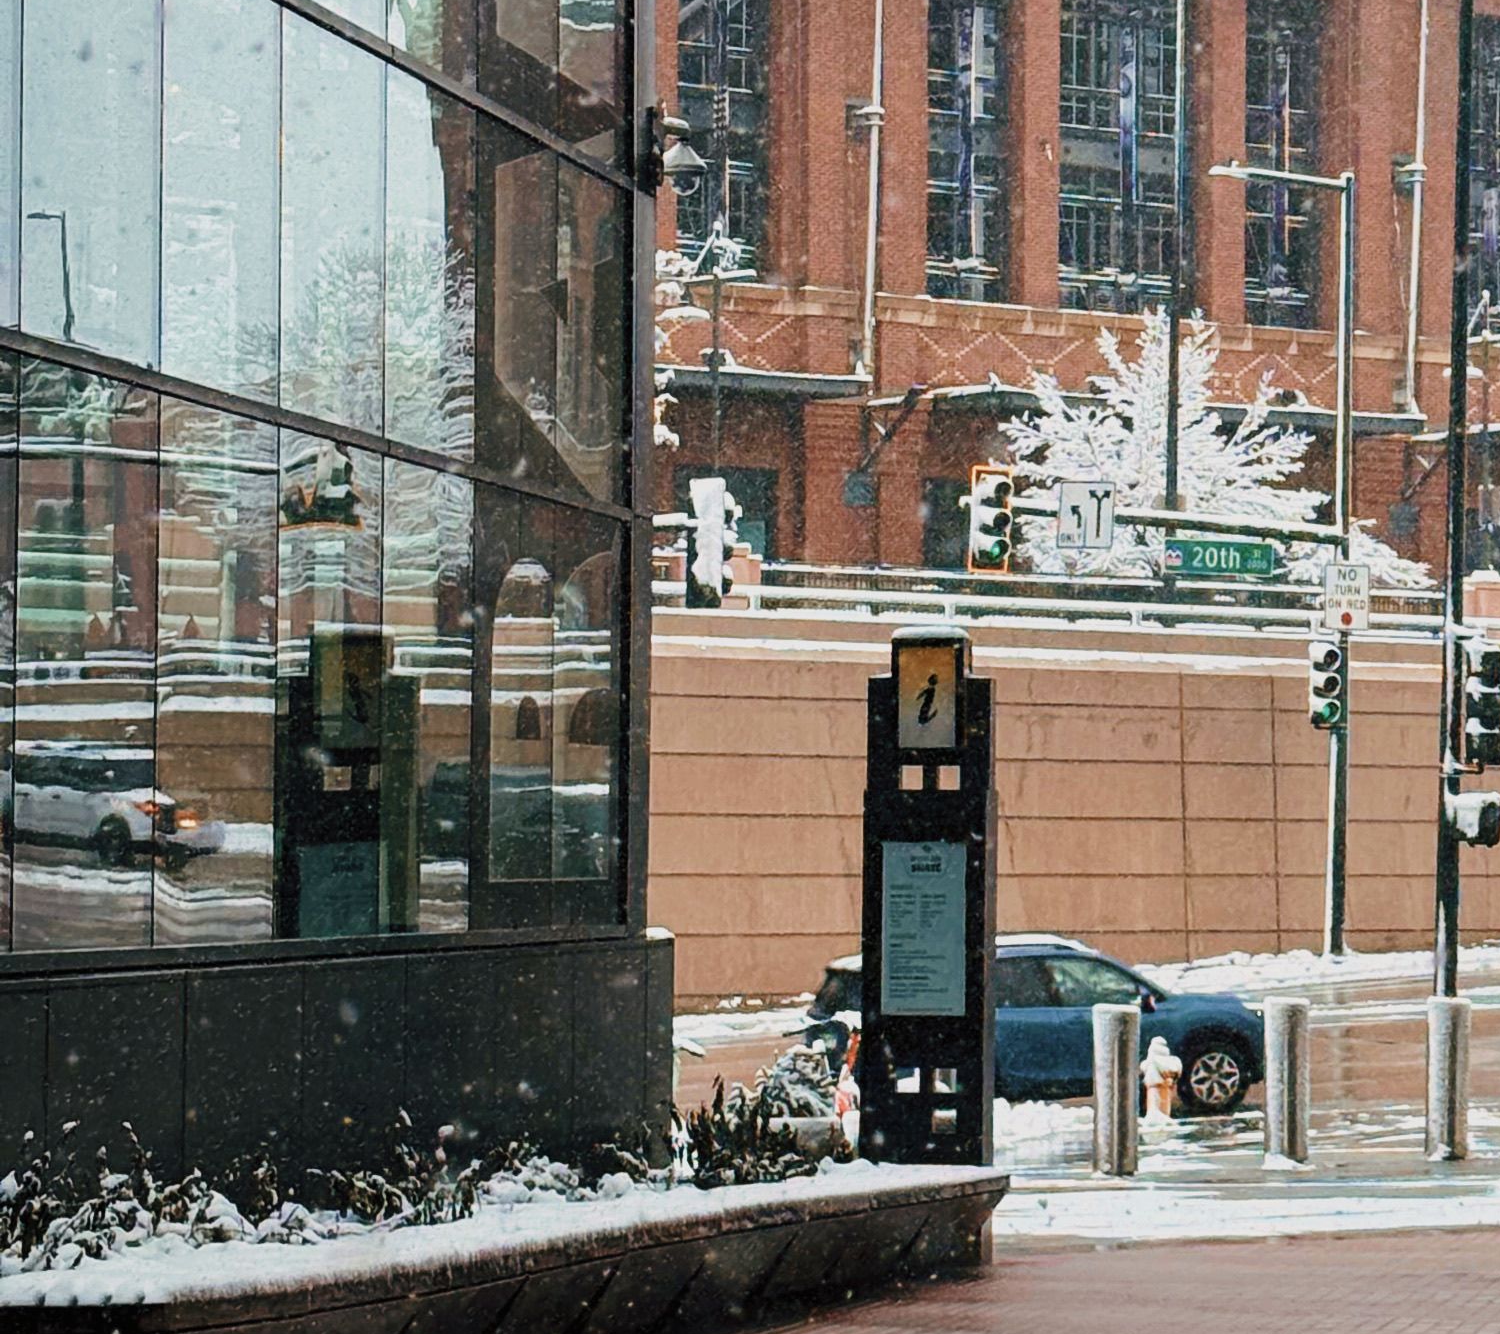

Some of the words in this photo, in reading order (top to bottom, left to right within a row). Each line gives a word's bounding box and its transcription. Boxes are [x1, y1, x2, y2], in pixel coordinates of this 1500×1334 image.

[1060, 533, 1082, 544] ONLY
[1192, 546, 1241, 569] 20th
[1337, 568, 1357, 581] NO
[1334, 584, 1361, 596] TURN
[1328, 597, 1342, 608] ON
[1346, 599, 1366, 610] RED
